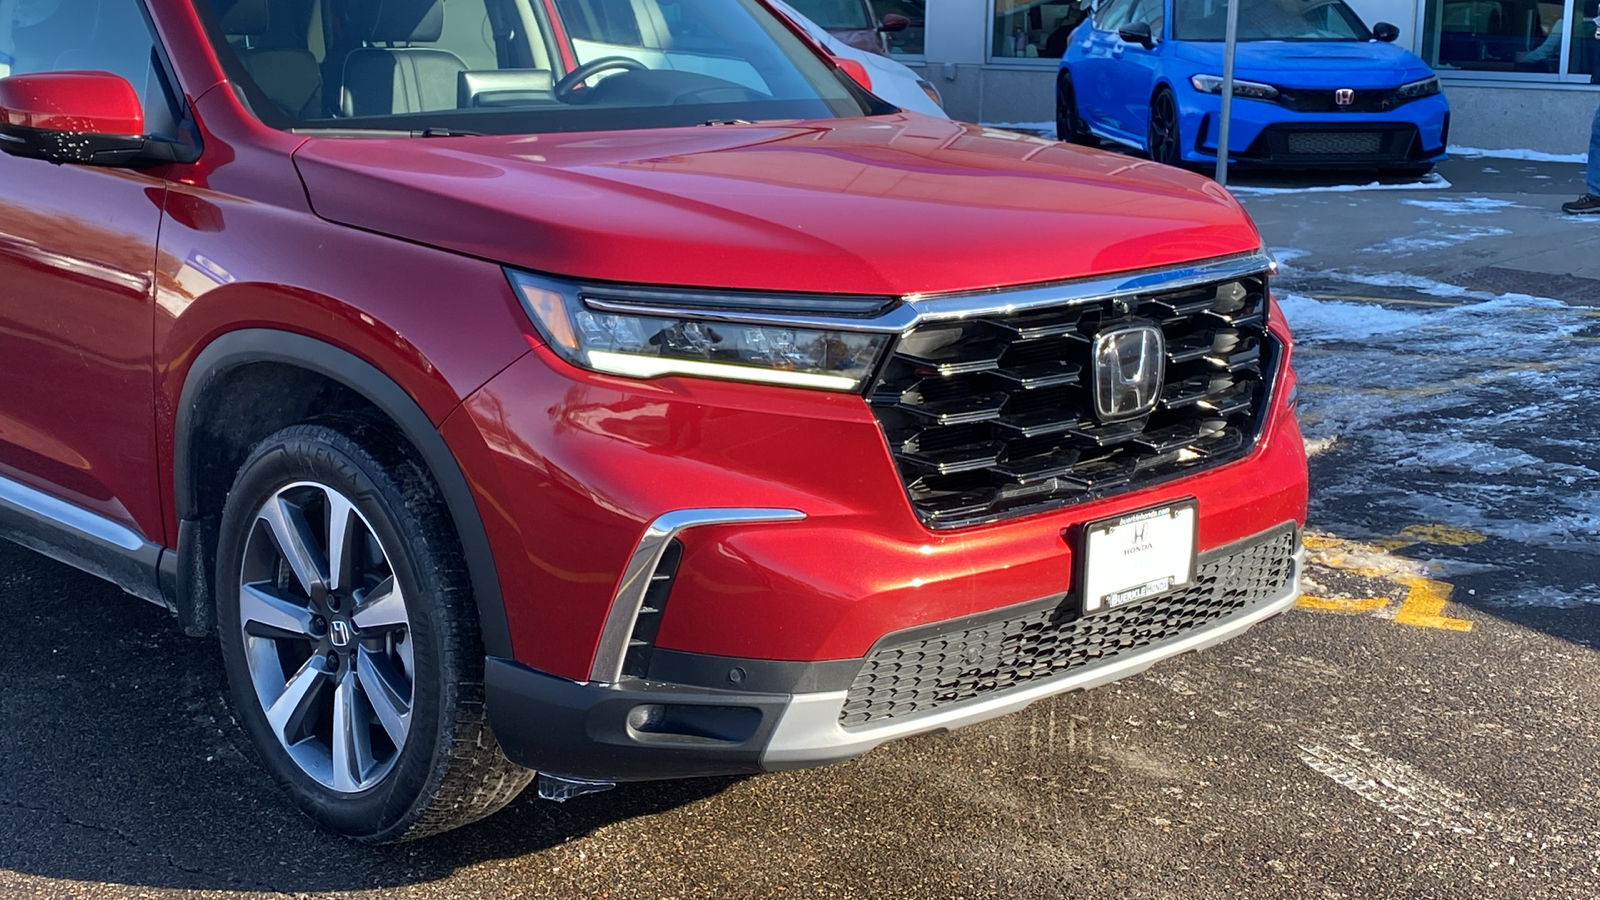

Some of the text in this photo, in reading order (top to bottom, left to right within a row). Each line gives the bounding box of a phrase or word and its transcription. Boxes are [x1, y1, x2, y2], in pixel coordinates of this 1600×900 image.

[295, 442, 359, 486] ALENZA
[1123, 542, 1153, 555] HONDA
[1109, 581, 1167, 607] BUERKLE HONDA
